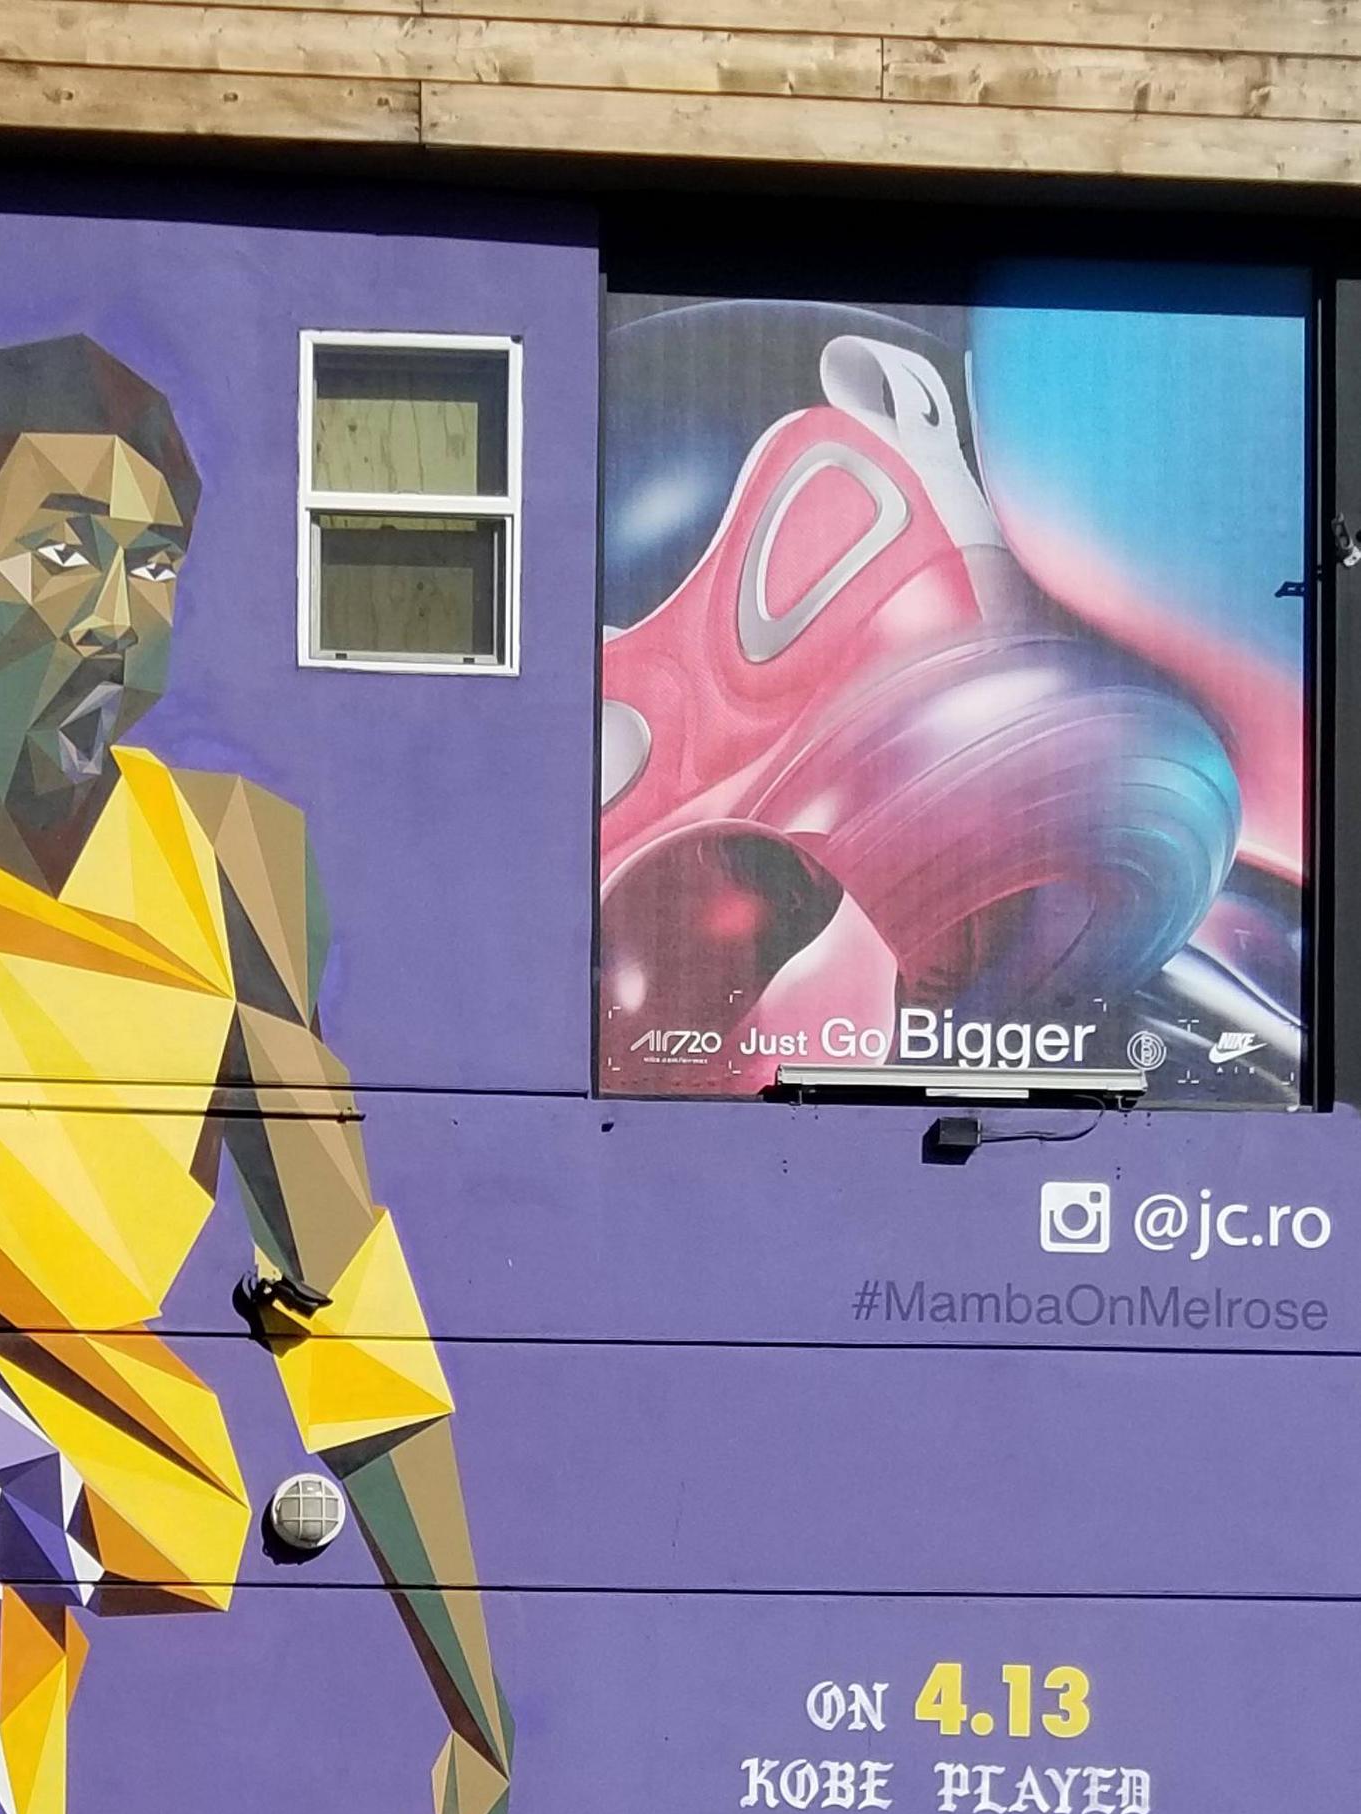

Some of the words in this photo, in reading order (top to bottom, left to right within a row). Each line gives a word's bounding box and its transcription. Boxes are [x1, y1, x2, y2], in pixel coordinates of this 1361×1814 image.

[740, 1027, 808, 1057] Just
[820, 1017, 888, 1059] Go
[898, 1007, 1096, 1069] Bigger
[1217, 1031, 1257, 1050] NIKE
[1133, 1188, 1332, 1260] @jc.ro
[851, 1279, 1329, 1331] #MambaOnMelrose
[805, 1680, 889, 1731] ON
[914, 1662, 1091, 1738] 4.13
[739, 1757, 894, 1810] KOBE
